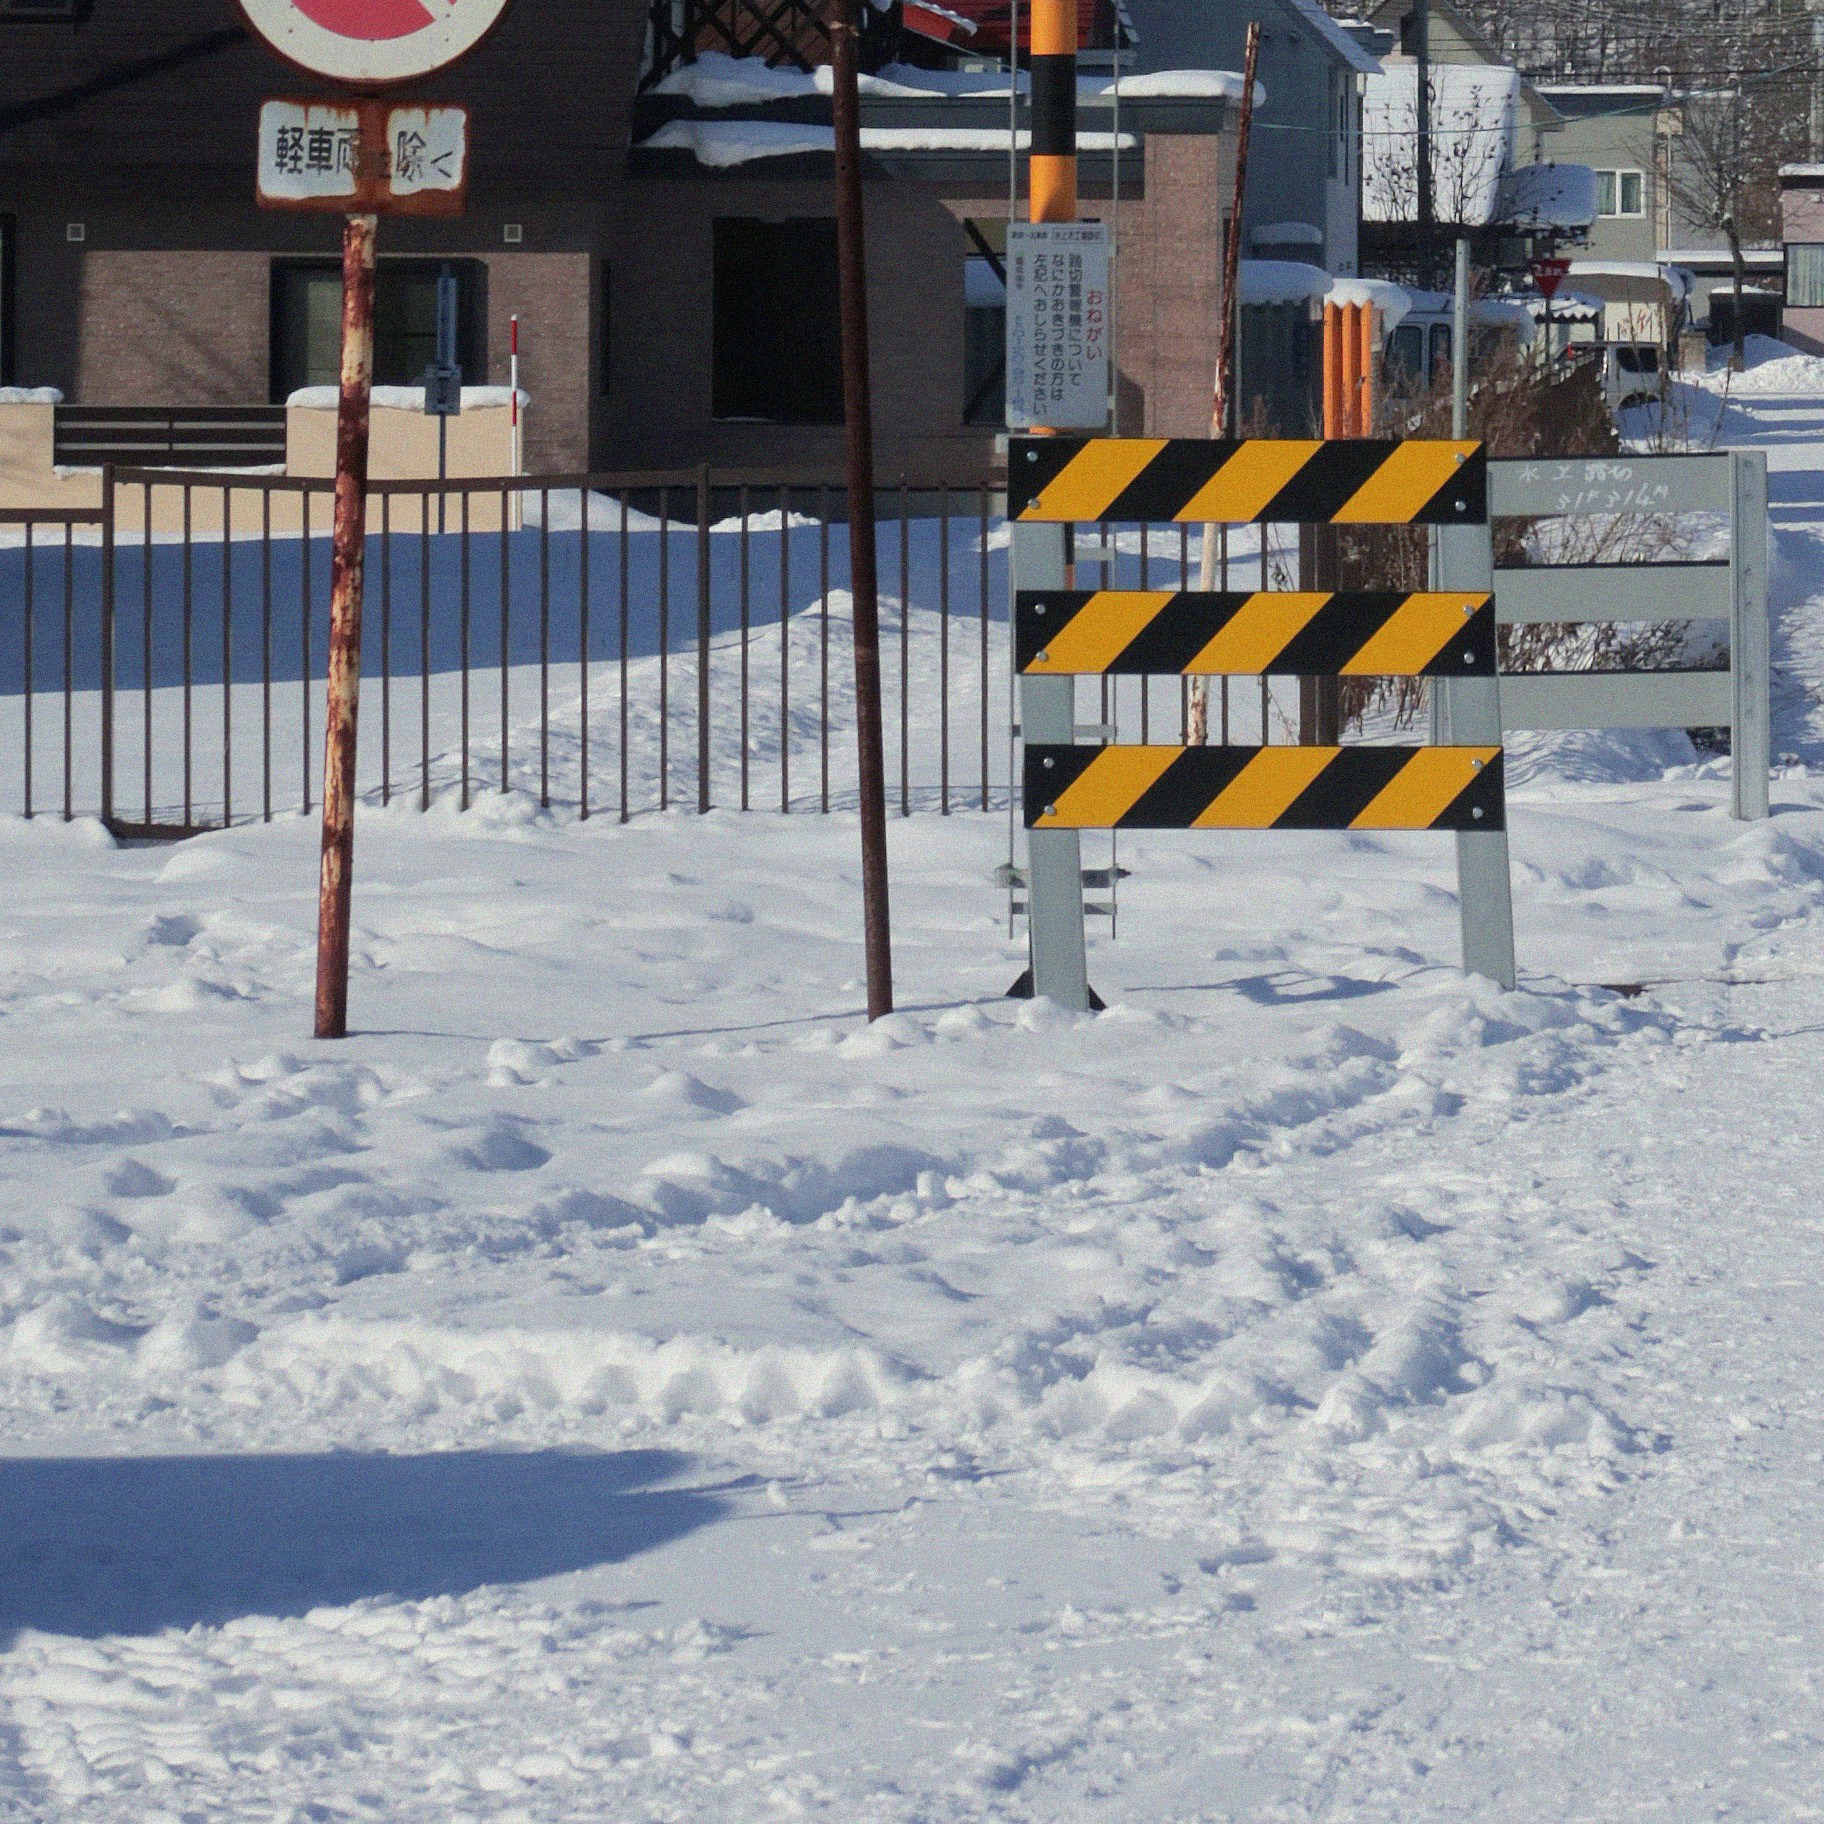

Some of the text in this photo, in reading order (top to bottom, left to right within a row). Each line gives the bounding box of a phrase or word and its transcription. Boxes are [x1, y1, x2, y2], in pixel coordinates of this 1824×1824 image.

[1033, 253, 1048, 416] 左記へおしらせください
[1086, 290, 1103, 361] おねがい
